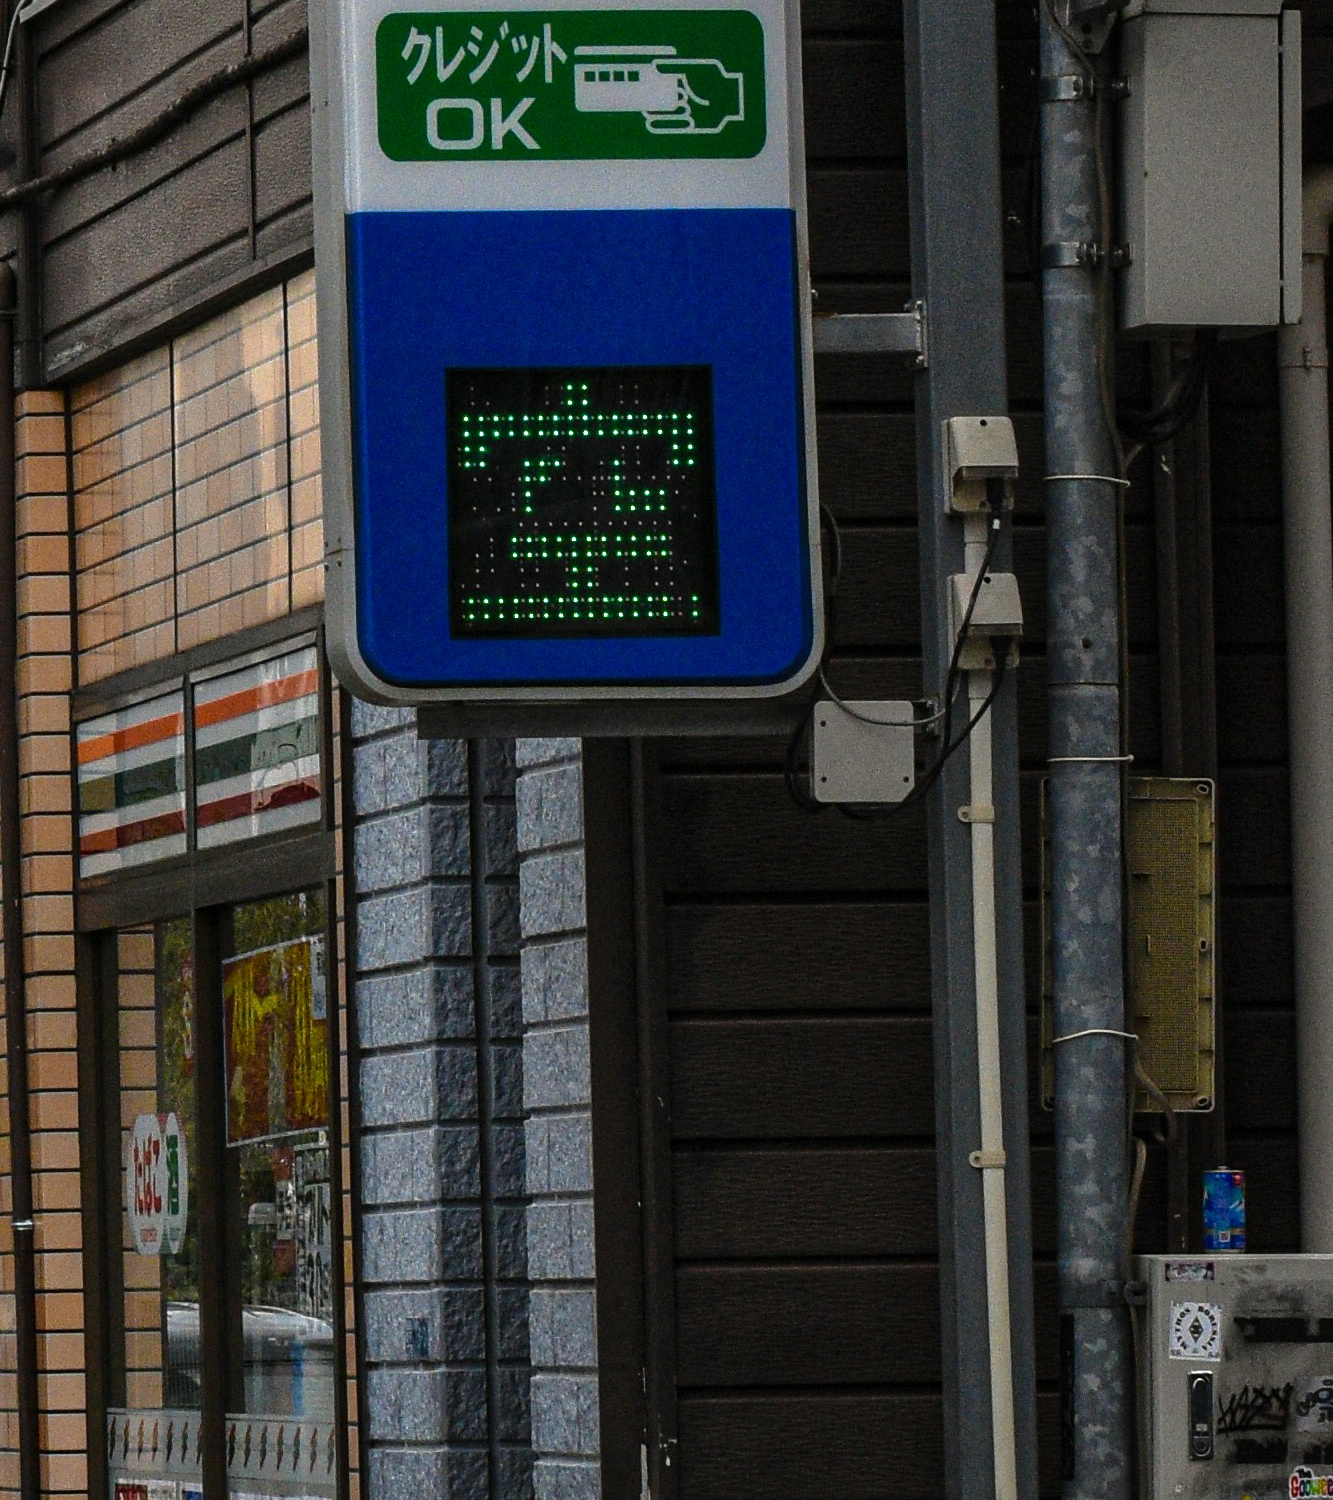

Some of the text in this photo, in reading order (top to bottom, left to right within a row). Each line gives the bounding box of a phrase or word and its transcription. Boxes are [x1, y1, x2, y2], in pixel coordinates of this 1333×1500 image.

[400, 22, 568, 90] クレジット
[425, 96, 541, 152] OK
